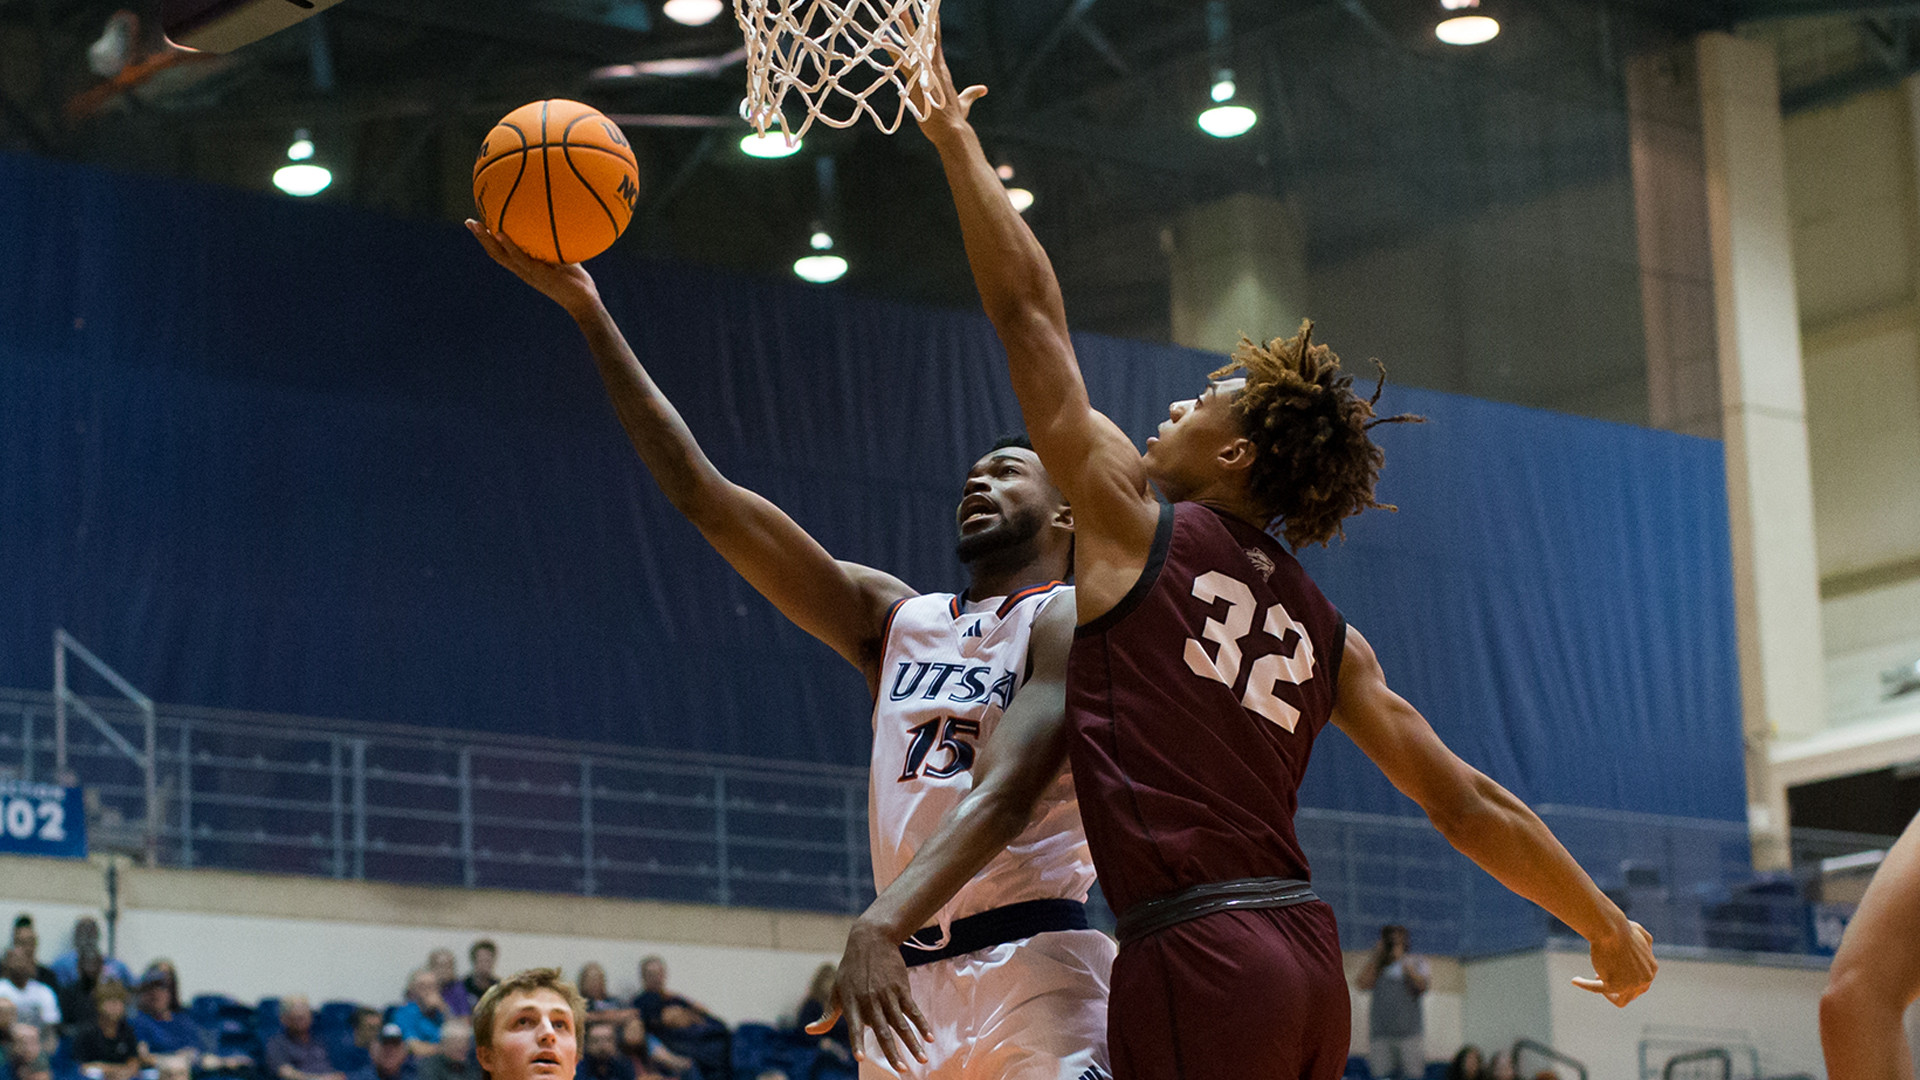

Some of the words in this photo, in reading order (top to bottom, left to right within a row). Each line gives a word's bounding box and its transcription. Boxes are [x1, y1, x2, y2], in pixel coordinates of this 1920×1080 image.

[1183, 570, 1315, 734] 32
[889, 662, 1017, 712] UTSA
[897, 715, 980, 783] 15
[0, 799, 66, 840] 02
